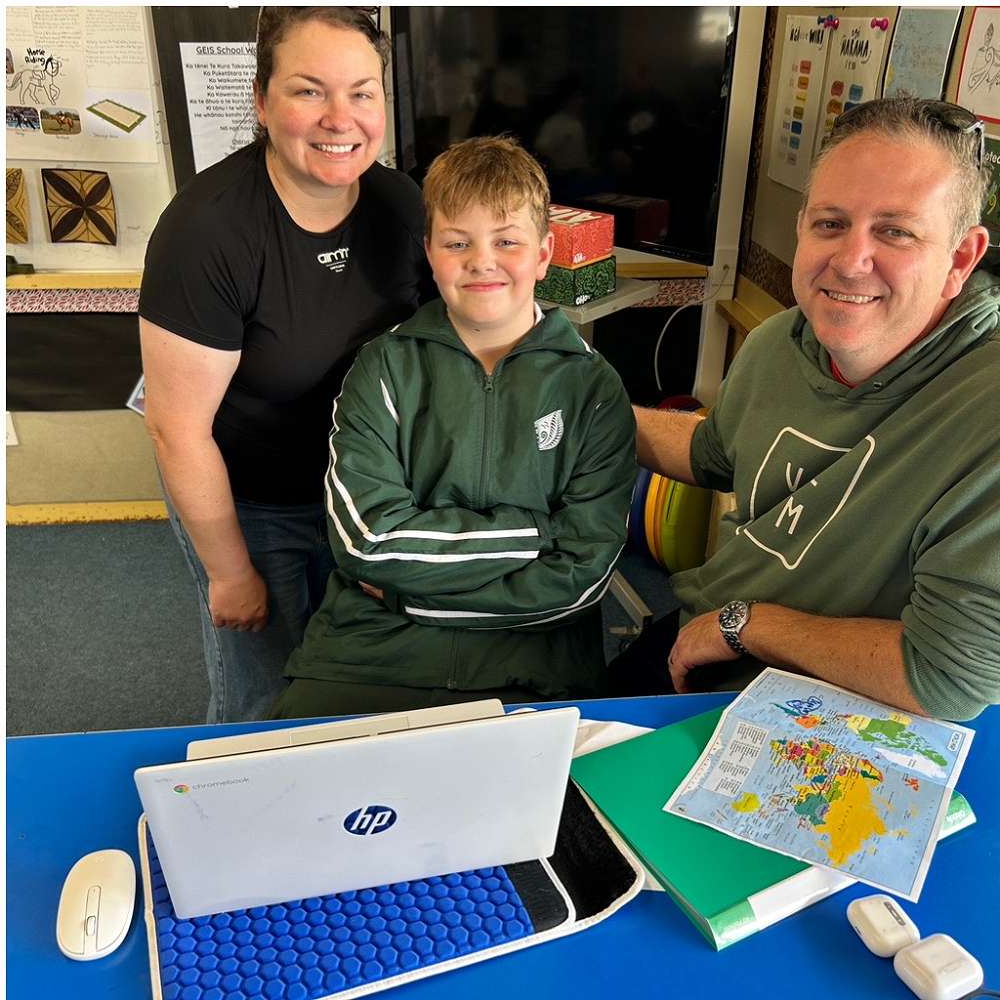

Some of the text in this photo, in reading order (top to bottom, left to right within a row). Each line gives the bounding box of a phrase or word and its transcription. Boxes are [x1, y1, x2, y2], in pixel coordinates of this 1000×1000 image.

[196, 46, 215, 55] GEIS
[217, 46, 243, 55] School
[349, 805, 394, 835] hp
